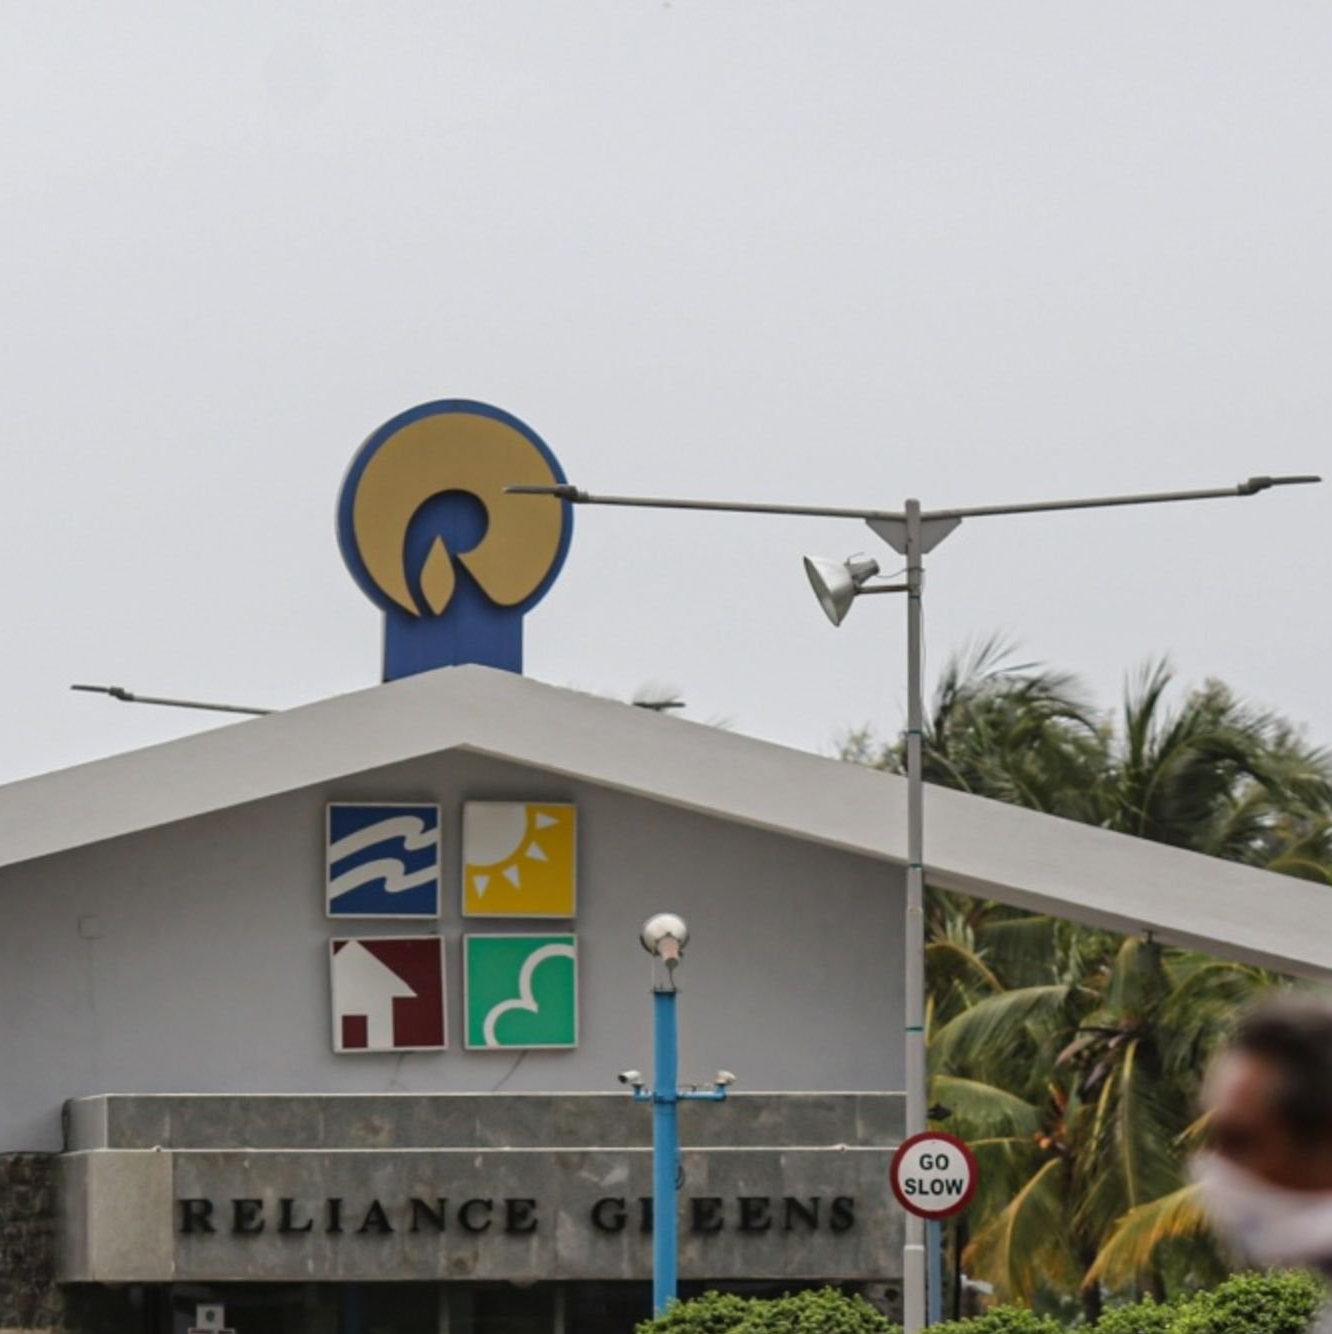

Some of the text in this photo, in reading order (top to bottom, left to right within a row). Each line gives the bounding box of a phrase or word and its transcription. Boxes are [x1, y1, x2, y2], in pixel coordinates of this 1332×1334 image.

[919, 1153, 949, 1171] GO
[904, 1178, 963, 1196] SLOW
[180, 1198, 538, 1234] RELIANCE
